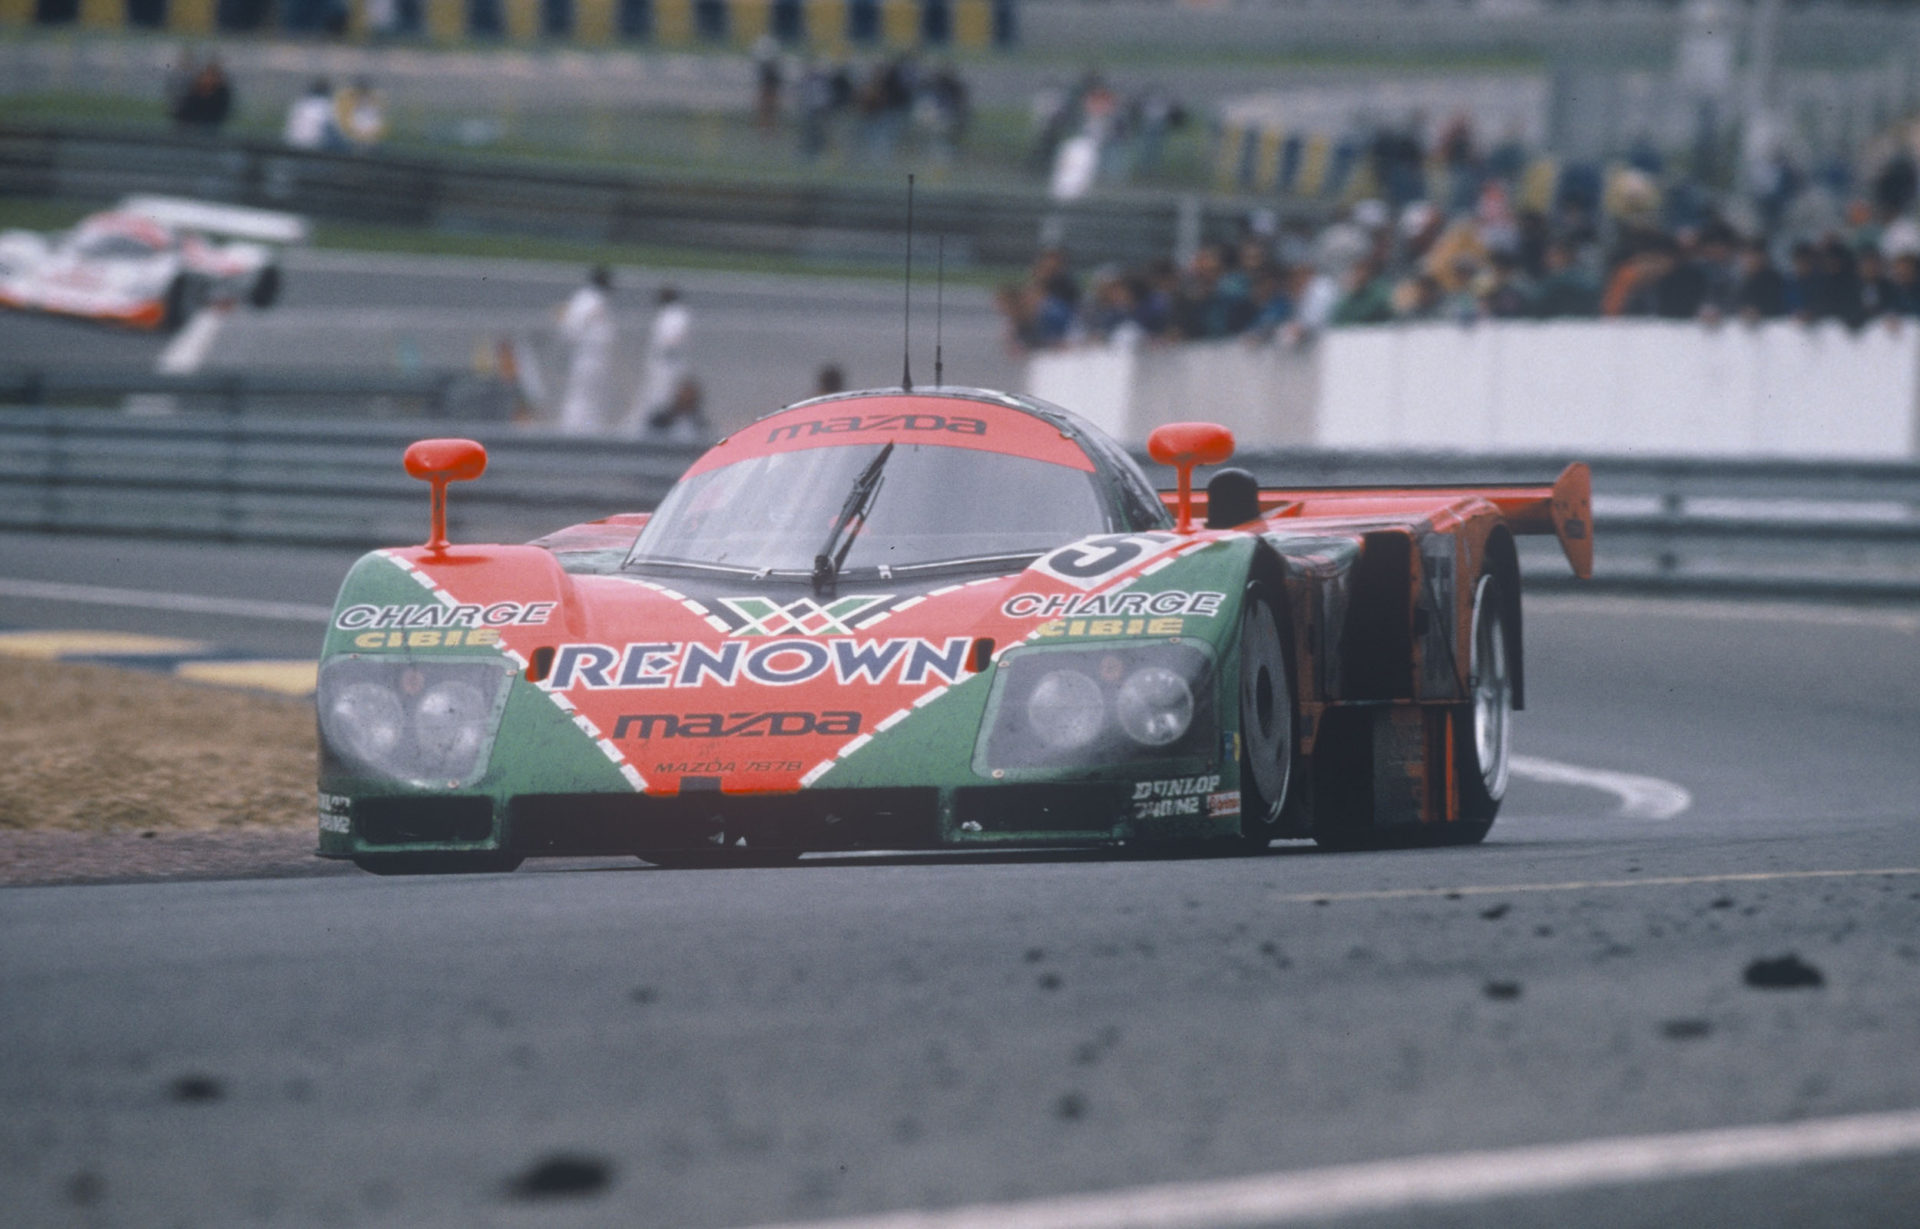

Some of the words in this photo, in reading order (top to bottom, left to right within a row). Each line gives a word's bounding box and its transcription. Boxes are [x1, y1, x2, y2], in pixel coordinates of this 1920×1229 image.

[335, 601, 558, 630] CHARGE
[1002, 590, 1227, 617] CHARGE
[354, 628, 501, 649] CIBIE
[1035, 617, 1184, 637] CIBIE
[548, 637, 975, 691] RENOWN
[654, 760, 737, 774] MAZDA
[1131, 775, 1221, 800] DUNLOP
